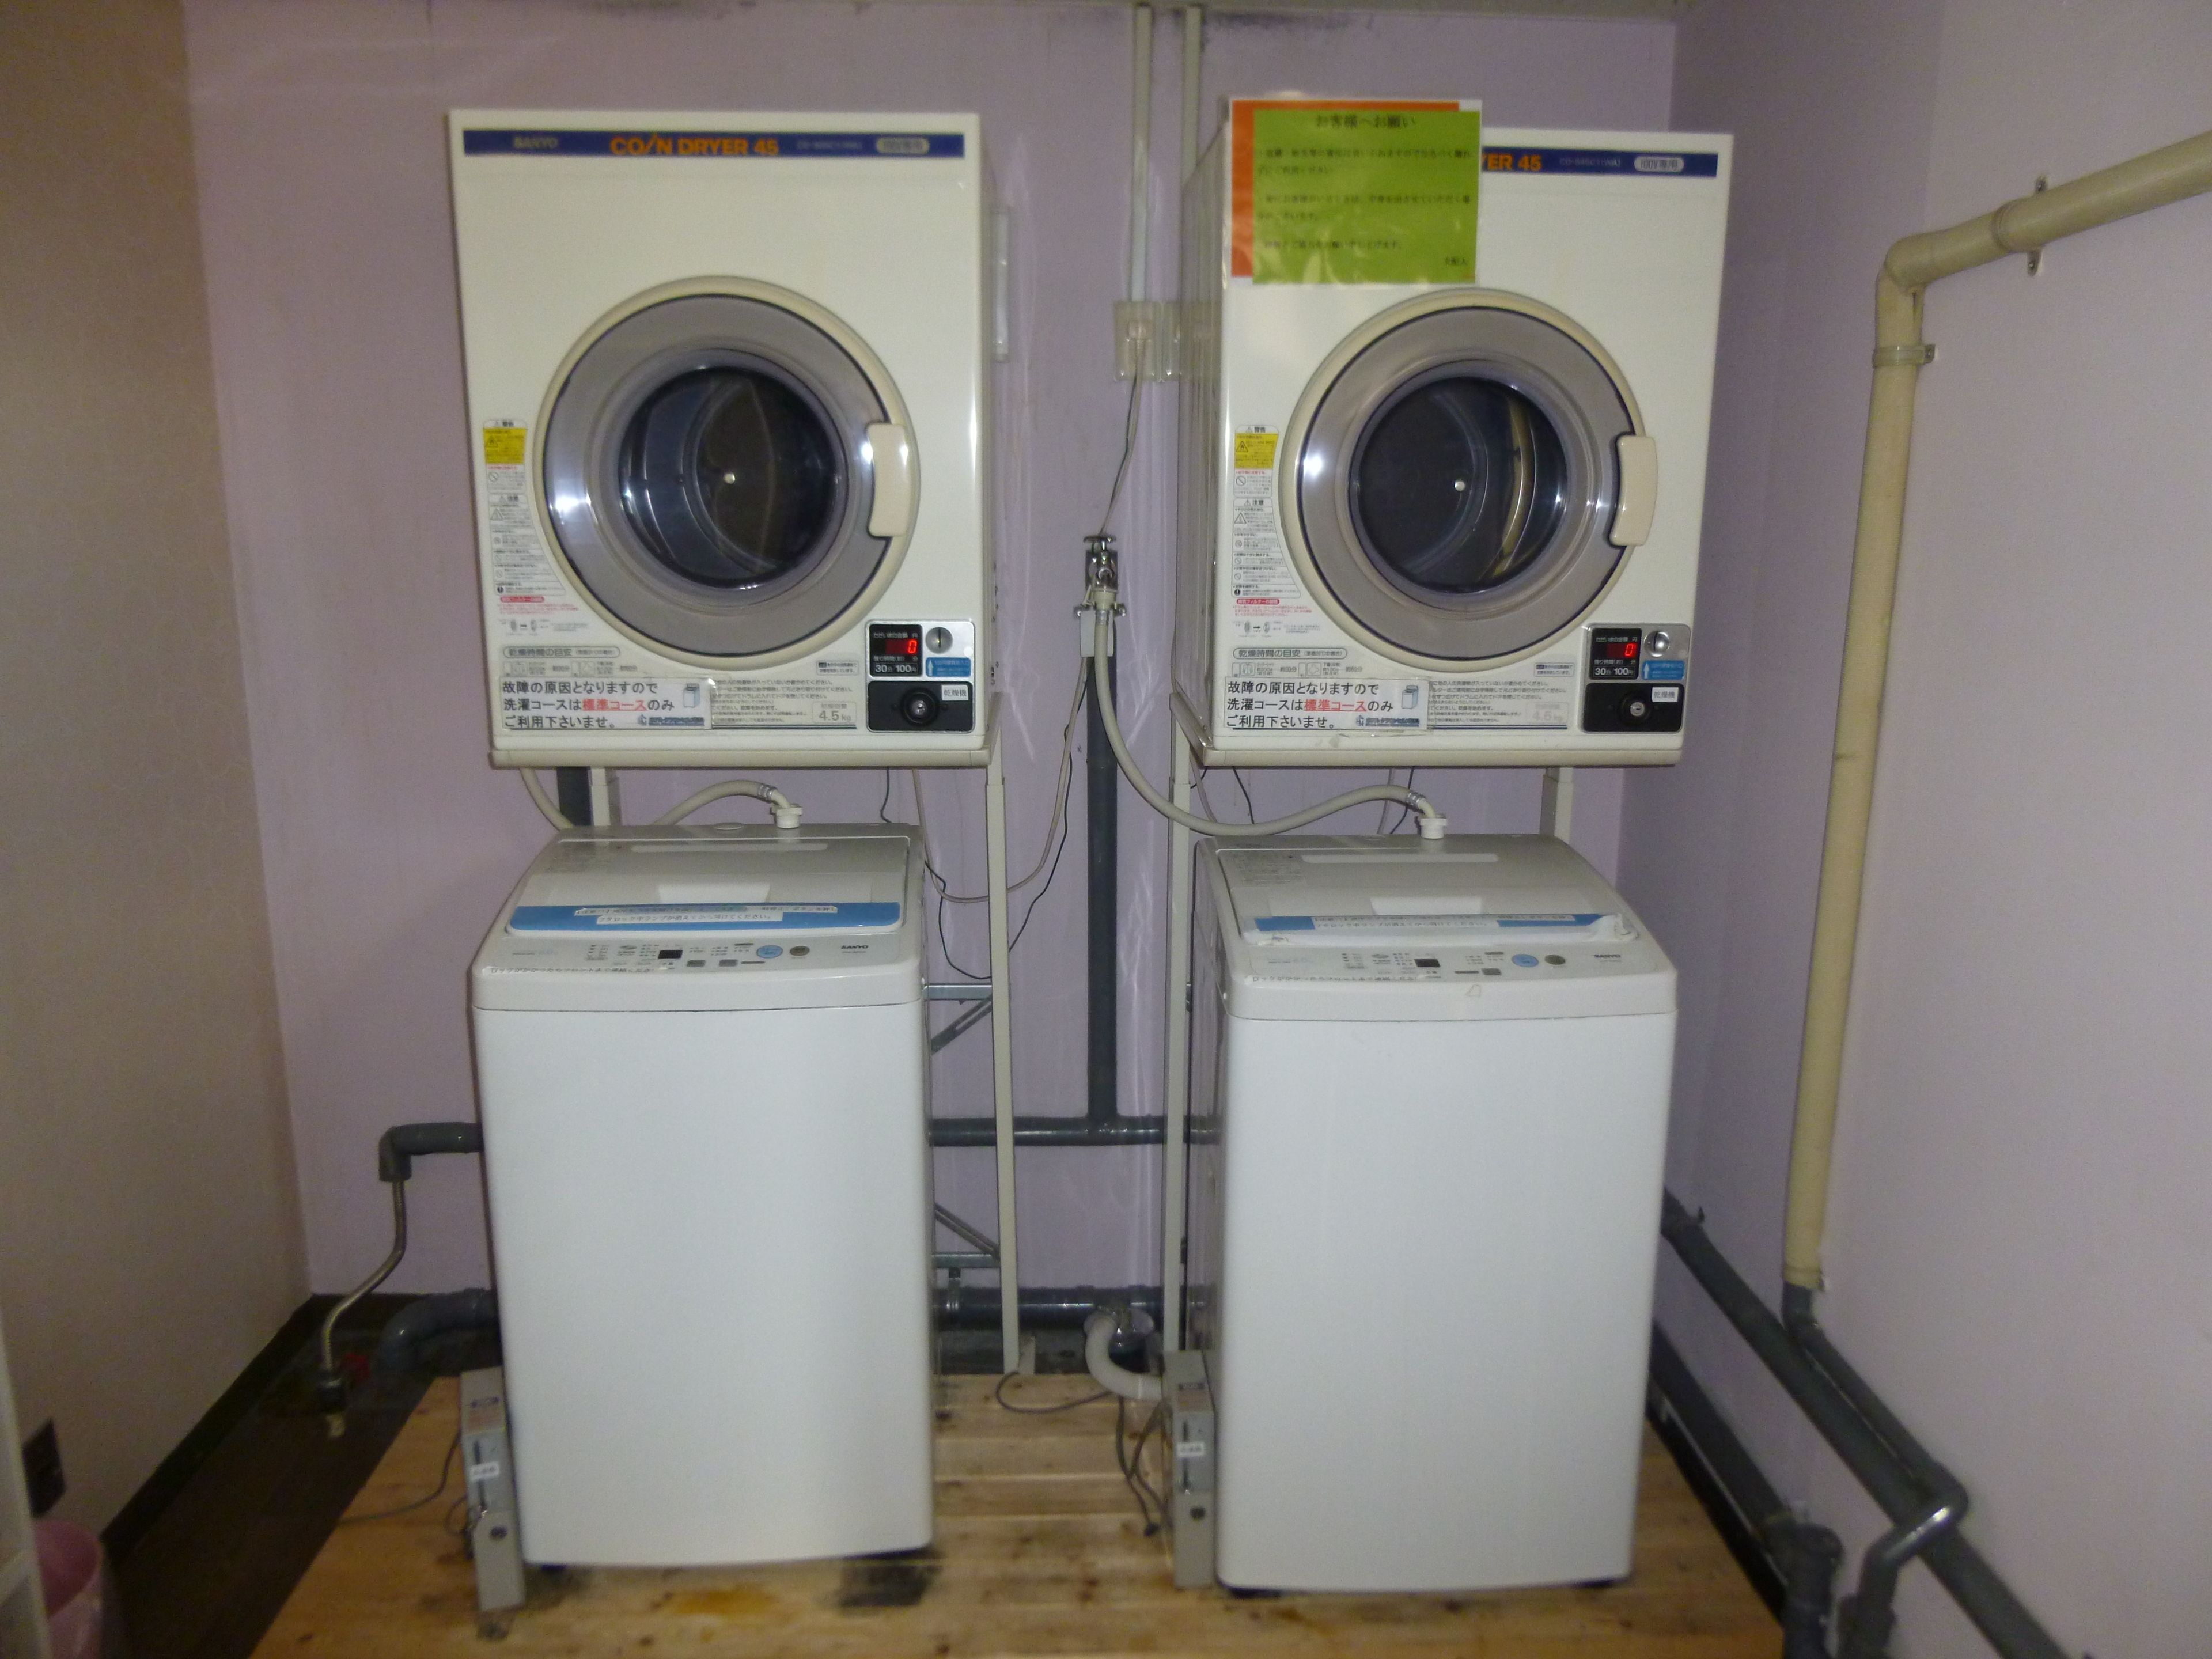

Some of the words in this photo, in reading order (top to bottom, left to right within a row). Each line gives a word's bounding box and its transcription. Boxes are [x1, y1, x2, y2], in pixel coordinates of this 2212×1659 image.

[677, 138, 748, 155] DRYER
[753, 138, 779, 156] 45
[1517, 153, 1542, 172] 45
[907, 639, 917, 654] 0
[1238, 649, 1301, 657] 乾燥時間の目安
[1624, 643, 1634, 657] 0
[896, 665, 916, 673] 100円
[1594, 668, 1611, 676] 30分
[1614, 668, 1634, 676] 100円
[503, 681, 658, 694] 故障の原因となりますので
[1228, 681, 1379, 695] 故障の原因となりますので
[503, 699, 675, 711] 洗濯コースは標準コースのみ
[1227, 699, 1393, 712] 洗濯コースは標準コースのみ
[505, 715, 615, 729] ご利用下さいませ。
[819, 710, 839, 721] 4.5
[1226, 715, 1335, 729] ご利用下さいませ。
